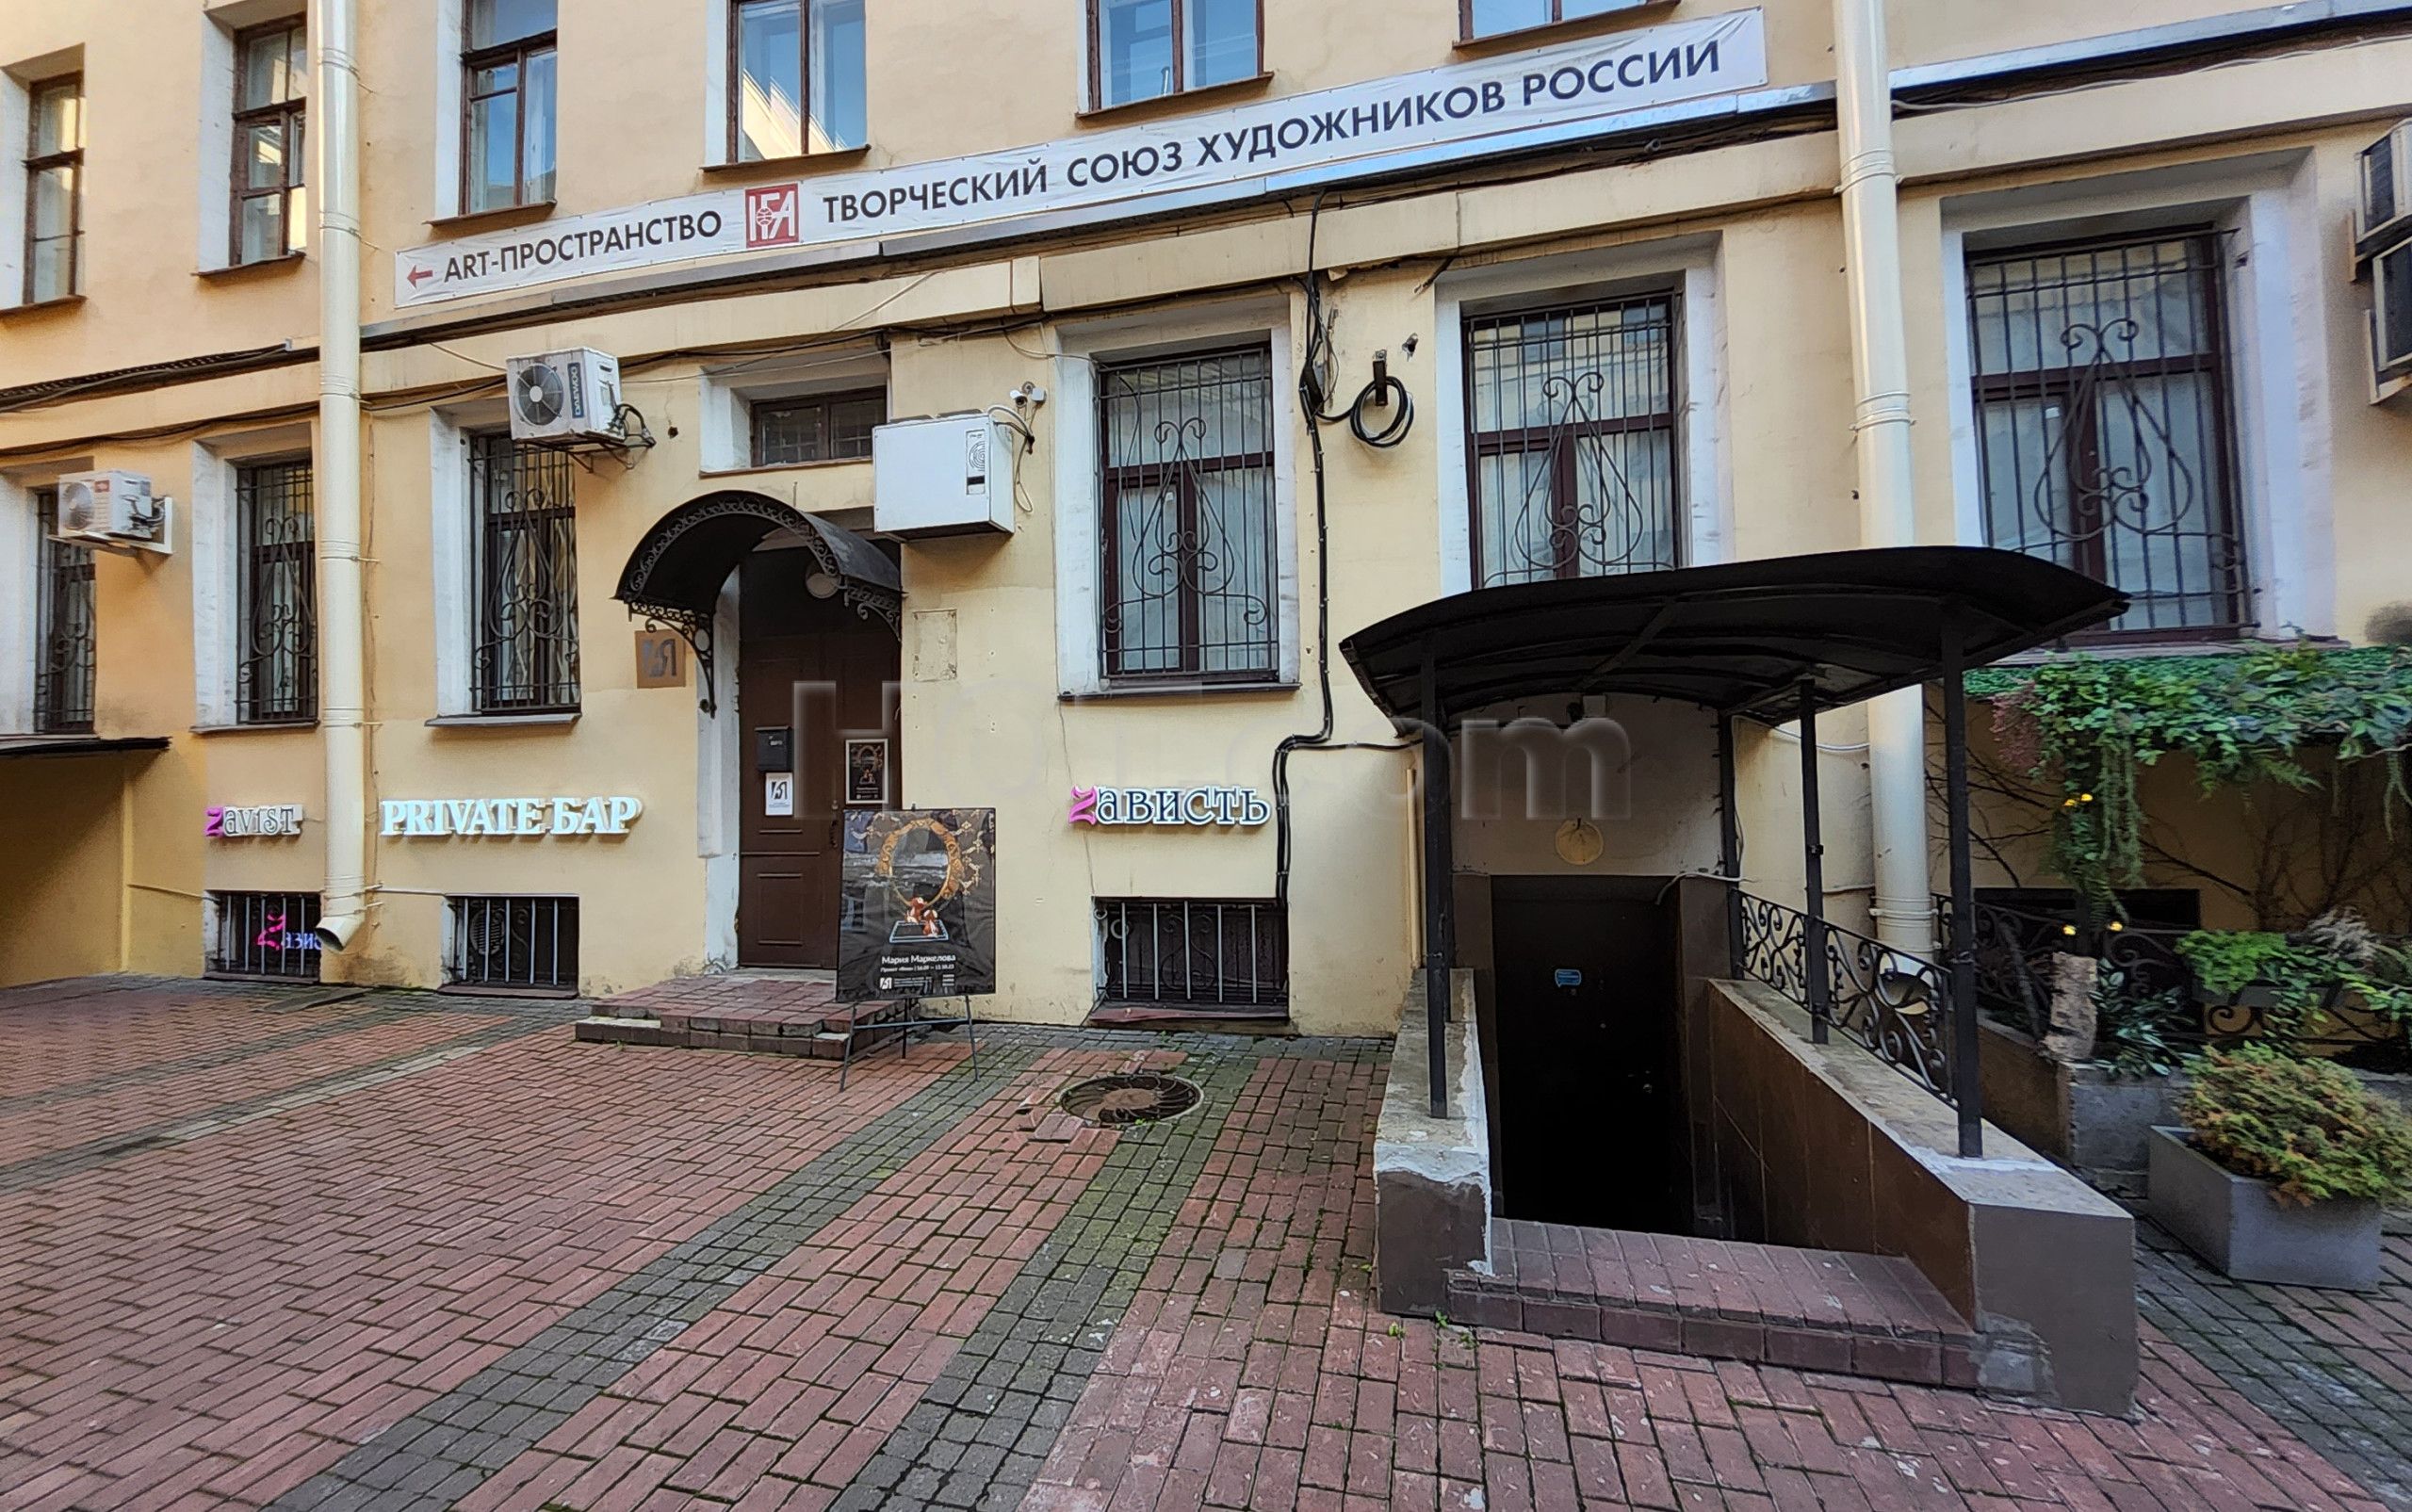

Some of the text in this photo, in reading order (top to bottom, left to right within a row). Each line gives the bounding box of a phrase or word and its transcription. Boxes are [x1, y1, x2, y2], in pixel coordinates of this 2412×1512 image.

[823, 40, 1720, 223] ТВОРЧЕСКИЙ СОЮЗ ХУДОЖНИКОВ РОССИИ
[444, 210, 722, 283] ART-ПРОСТРАНСТВО
[381, 796, 640, 836] PRIVATE БАР
